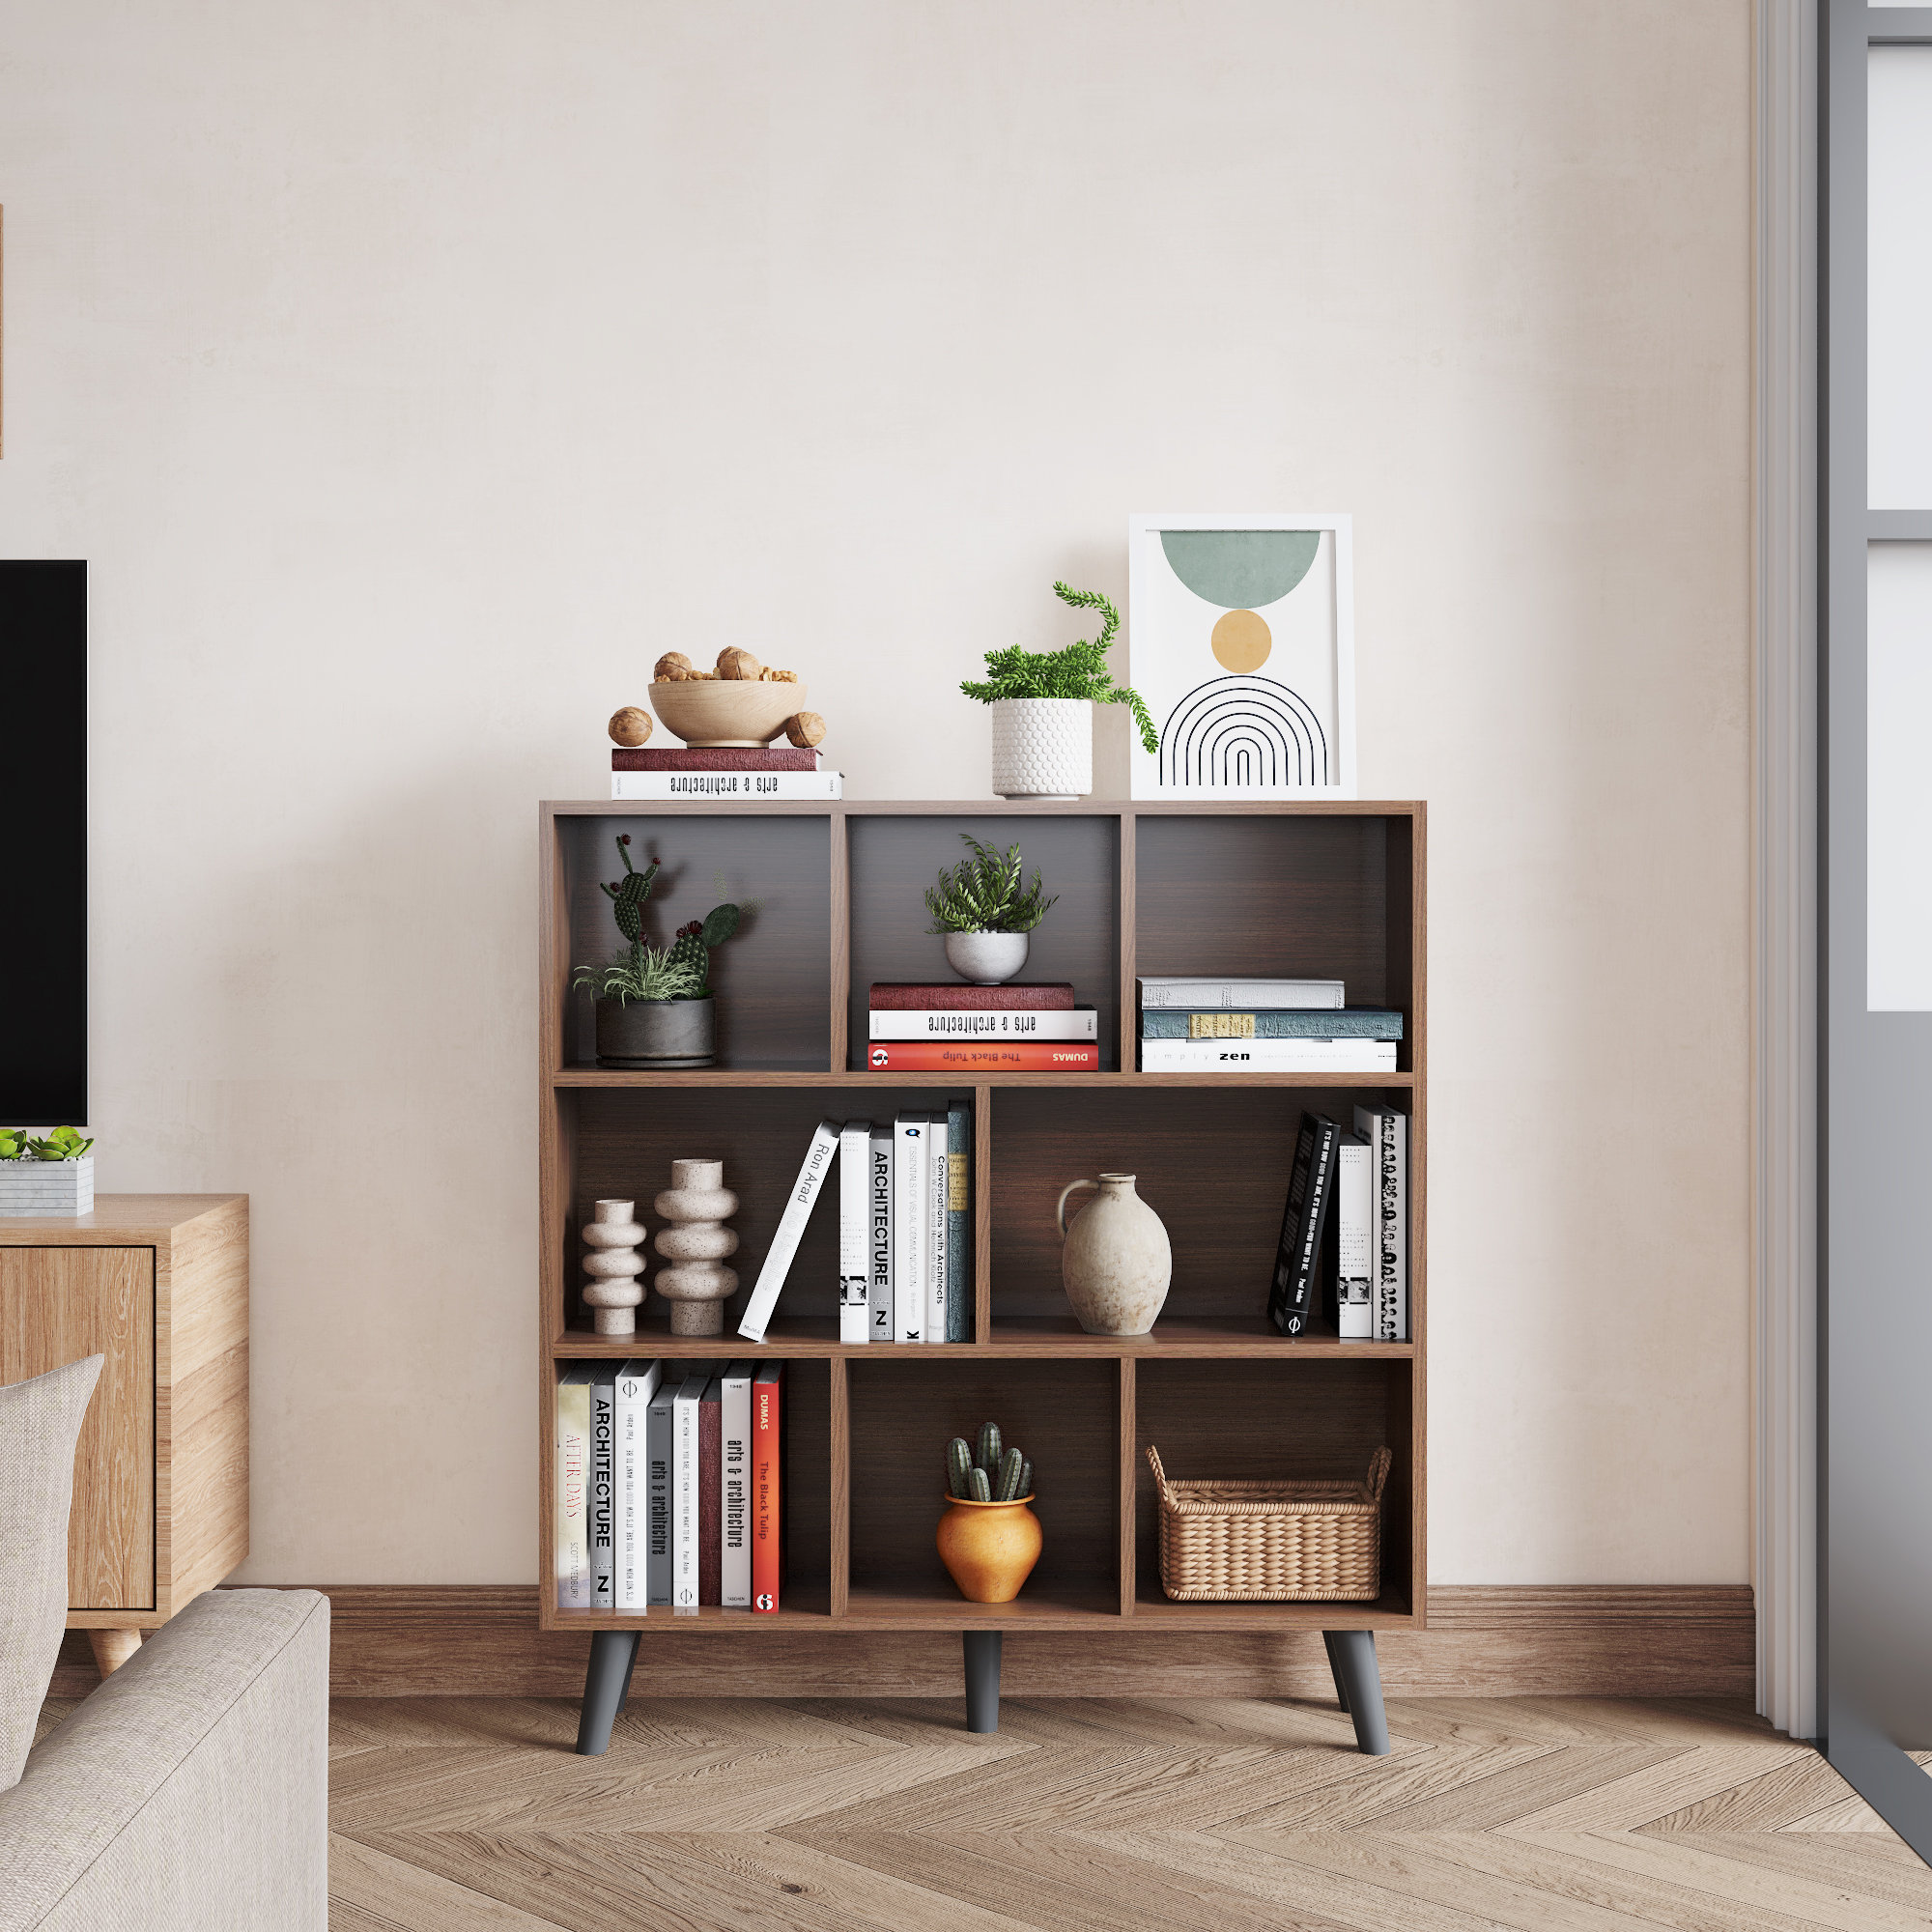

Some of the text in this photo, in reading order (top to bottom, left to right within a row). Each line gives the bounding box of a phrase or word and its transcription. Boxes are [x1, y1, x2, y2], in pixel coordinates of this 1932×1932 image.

[670, 777, 778, 795] arts & architecture
[929, 1017, 1036, 1035] arts & architecture
[943, 1051, 968, 1062] Tulip
[972, 1053, 999, 1062] Black
[1323, 1130, 1332, 1140] IT'S
[798, 1144, 830, 1204] Ron Arad
[875, 1151, 888, 1286] ARCHITECTURE
[1312, 1197, 1321, 1207] IT'S
[936, 1254, 945, 1304] Architects
[1295, 1289, 1304, 1303] Arden
[760, 1395, 769, 1430] DUMAS
[727, 1440, 744, 1462] arts
[566, 1435, 582, 1519] AFTER DAYS
[596, 1399, 611, 1548] ARCHITECTURE
[651, 1461, 667, 1479] arts
[727, 1480, 746, 1548] architecture
[758, 1462, 769, 1540] The Black Tulip
[651, 1496, 668, 1555] architecture
[570, 1542, 579, 1599] SCOTT MEDBURY
